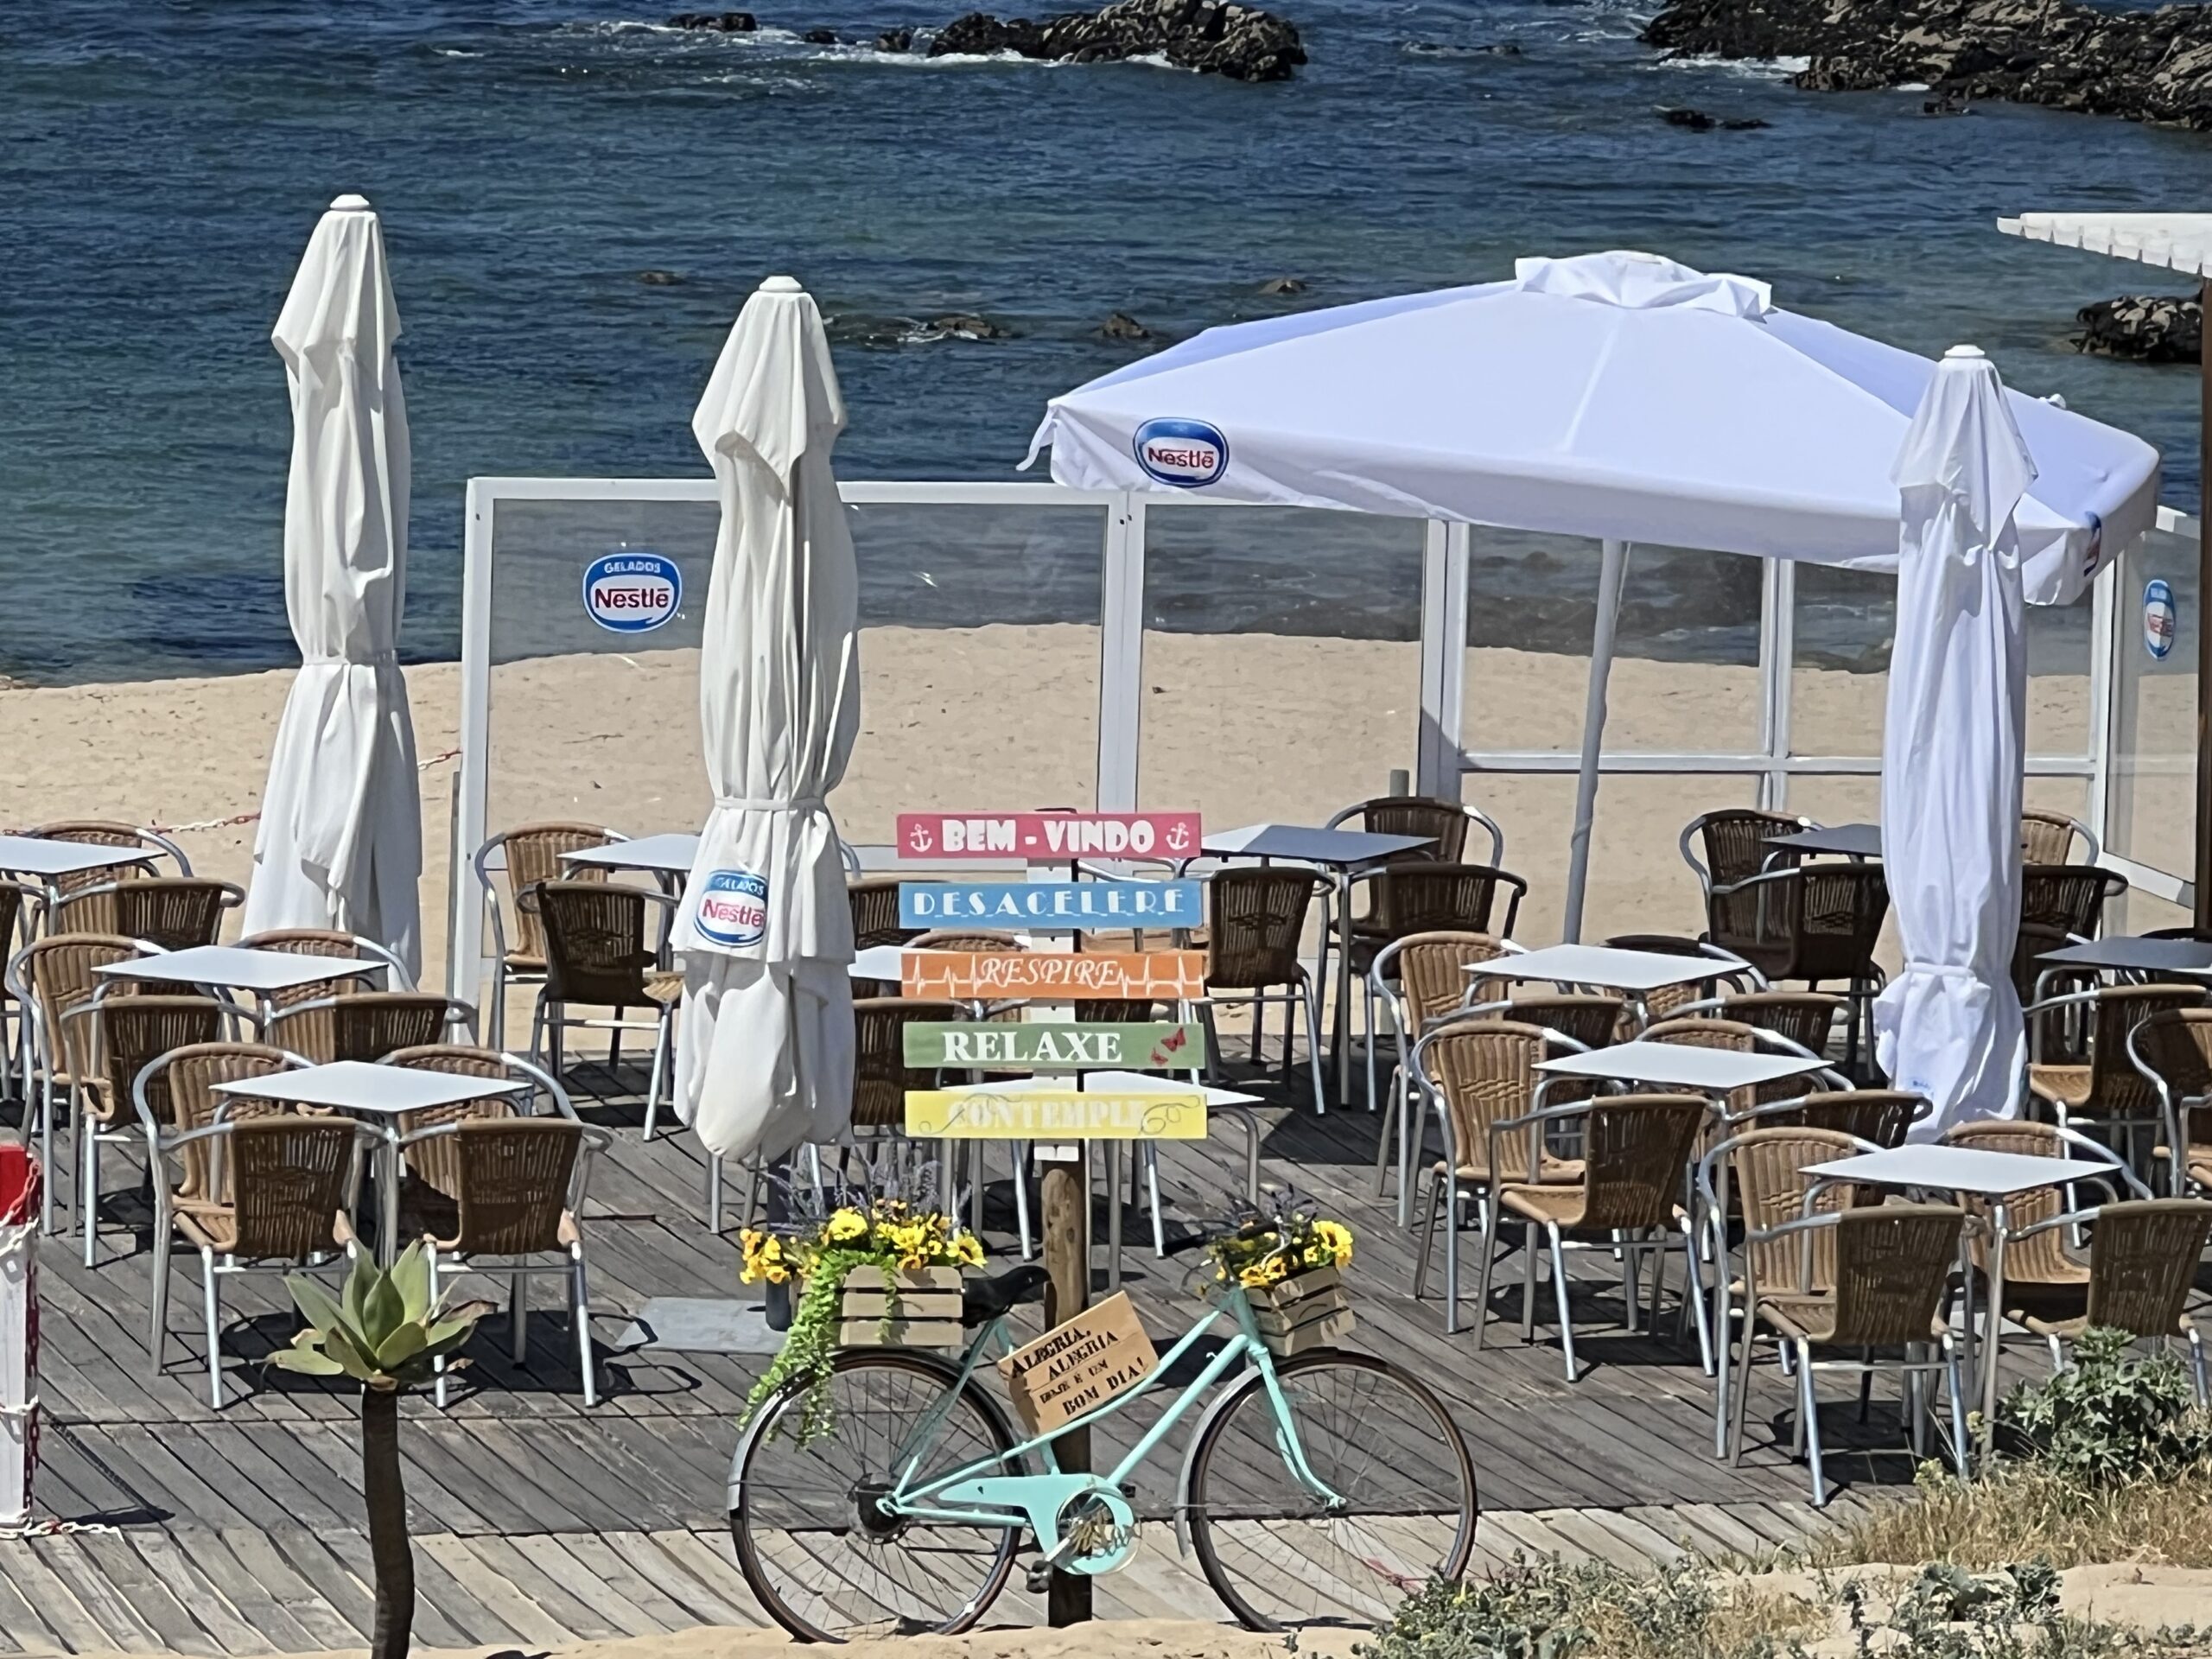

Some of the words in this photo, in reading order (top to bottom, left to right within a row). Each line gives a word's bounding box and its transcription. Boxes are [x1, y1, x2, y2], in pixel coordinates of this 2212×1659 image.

[1147, 446, 1215, 469] Nestlé
[603, 560, 661, 574] GELADOS
[594, 587, 671, 609] Nestlé
[941, 818, 1017, 853] BEM
[1043, 819, 1156, 854] VINDO
[913, 888, 1185, 918] DESACELERE
[980, 957, 1122, 989] RESPIRE
[941, 1030, 1122, 1064] RELAXE
[1047, 1330, 1121, 1382] ALEGRIA
[1062, 1385, 1100, 1416] BOM
[1106, 1356, 1149, 1391] DIA!
